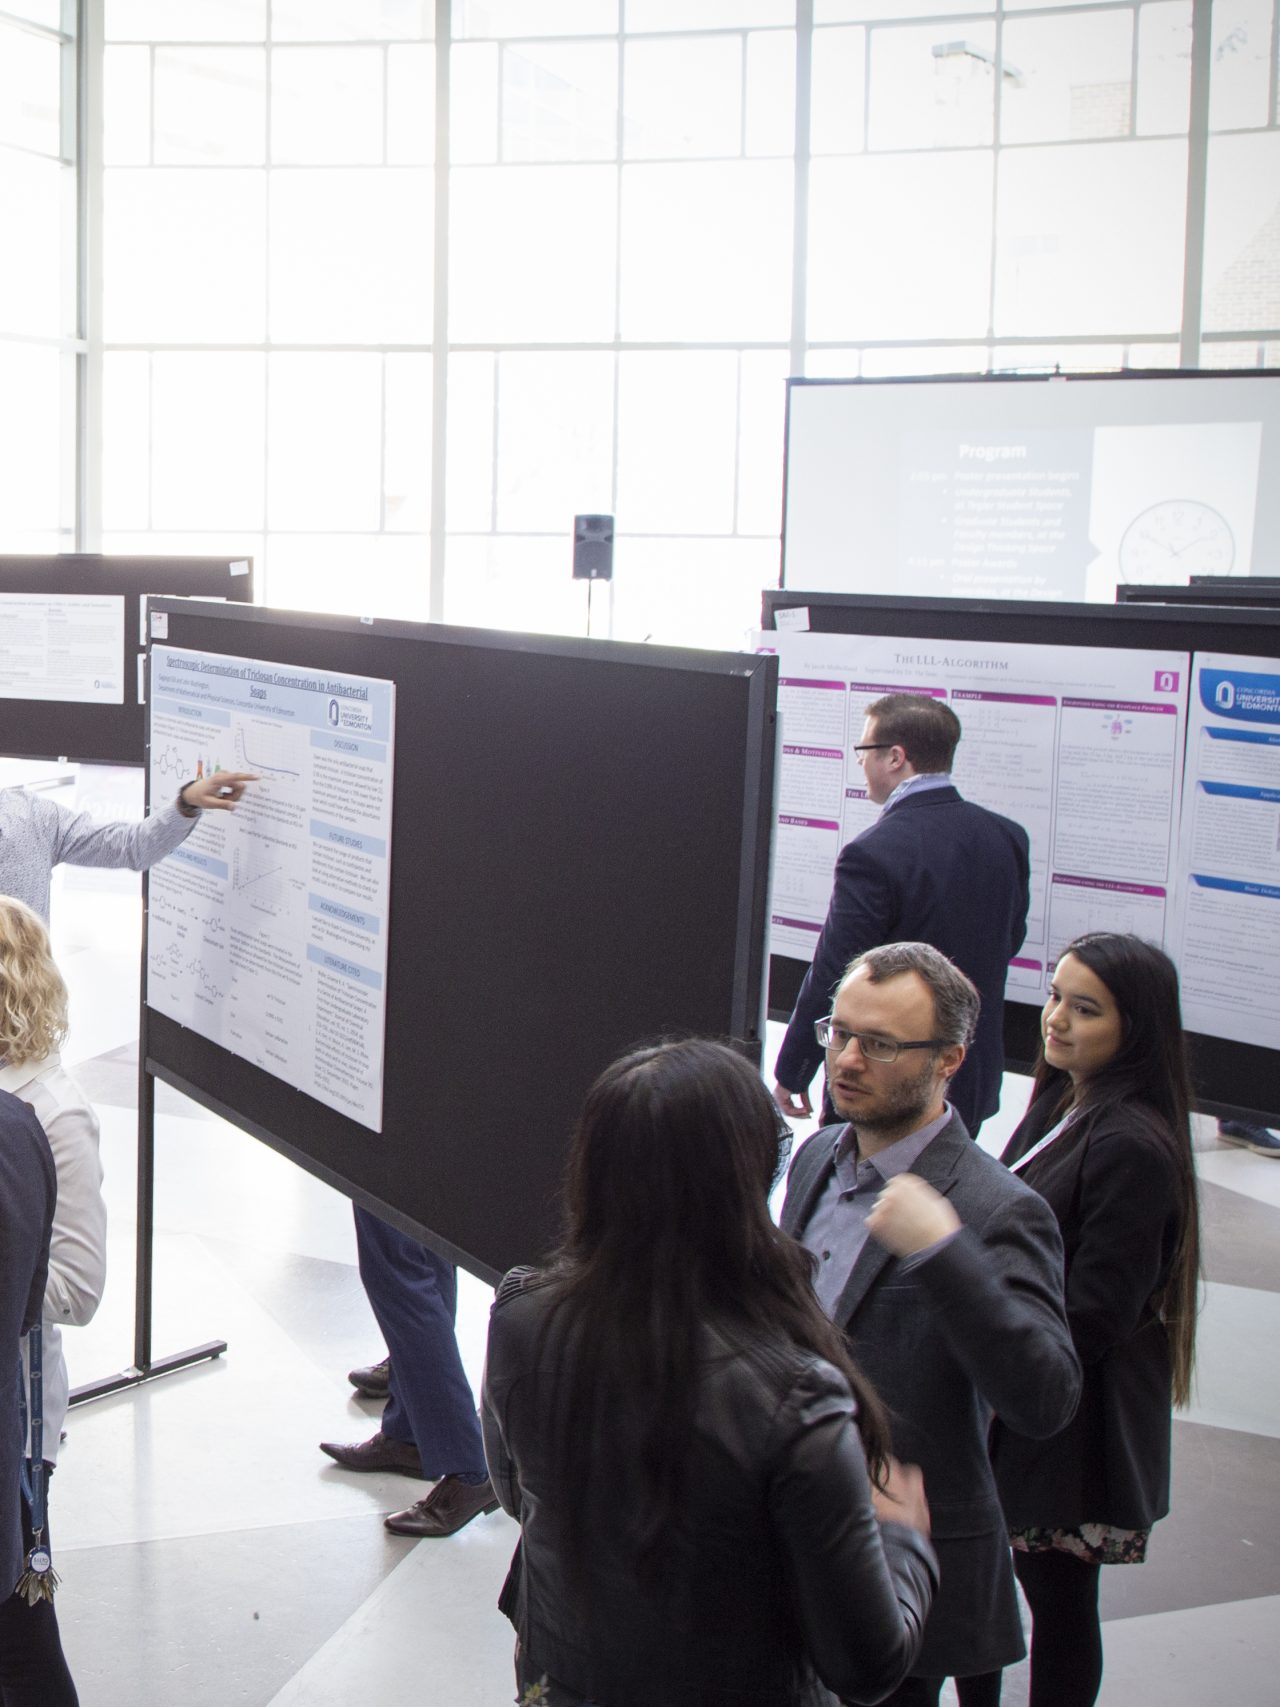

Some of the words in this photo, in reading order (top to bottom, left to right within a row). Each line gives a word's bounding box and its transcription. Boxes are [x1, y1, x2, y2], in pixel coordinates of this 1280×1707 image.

[959, 444, 1027, 462] Program
[986, 472, 1045, 482] presentation
[167, 656, 200, 671] Spectroscopic
[201, 661, 239, 677] Determination
[240, 667, 247, 679] of
[248, 668, 272, 683] Triclosan
[274, 672, 317, 691] Concentration
[319, 679, 325, 692] in
[326, 680, 368, 699] Antibacterial
[250, 684, 267, 699] Soaps
[340, 711, 369, 722] UNIVERSITY
[344, 720, 372, 731] EDMONTON
